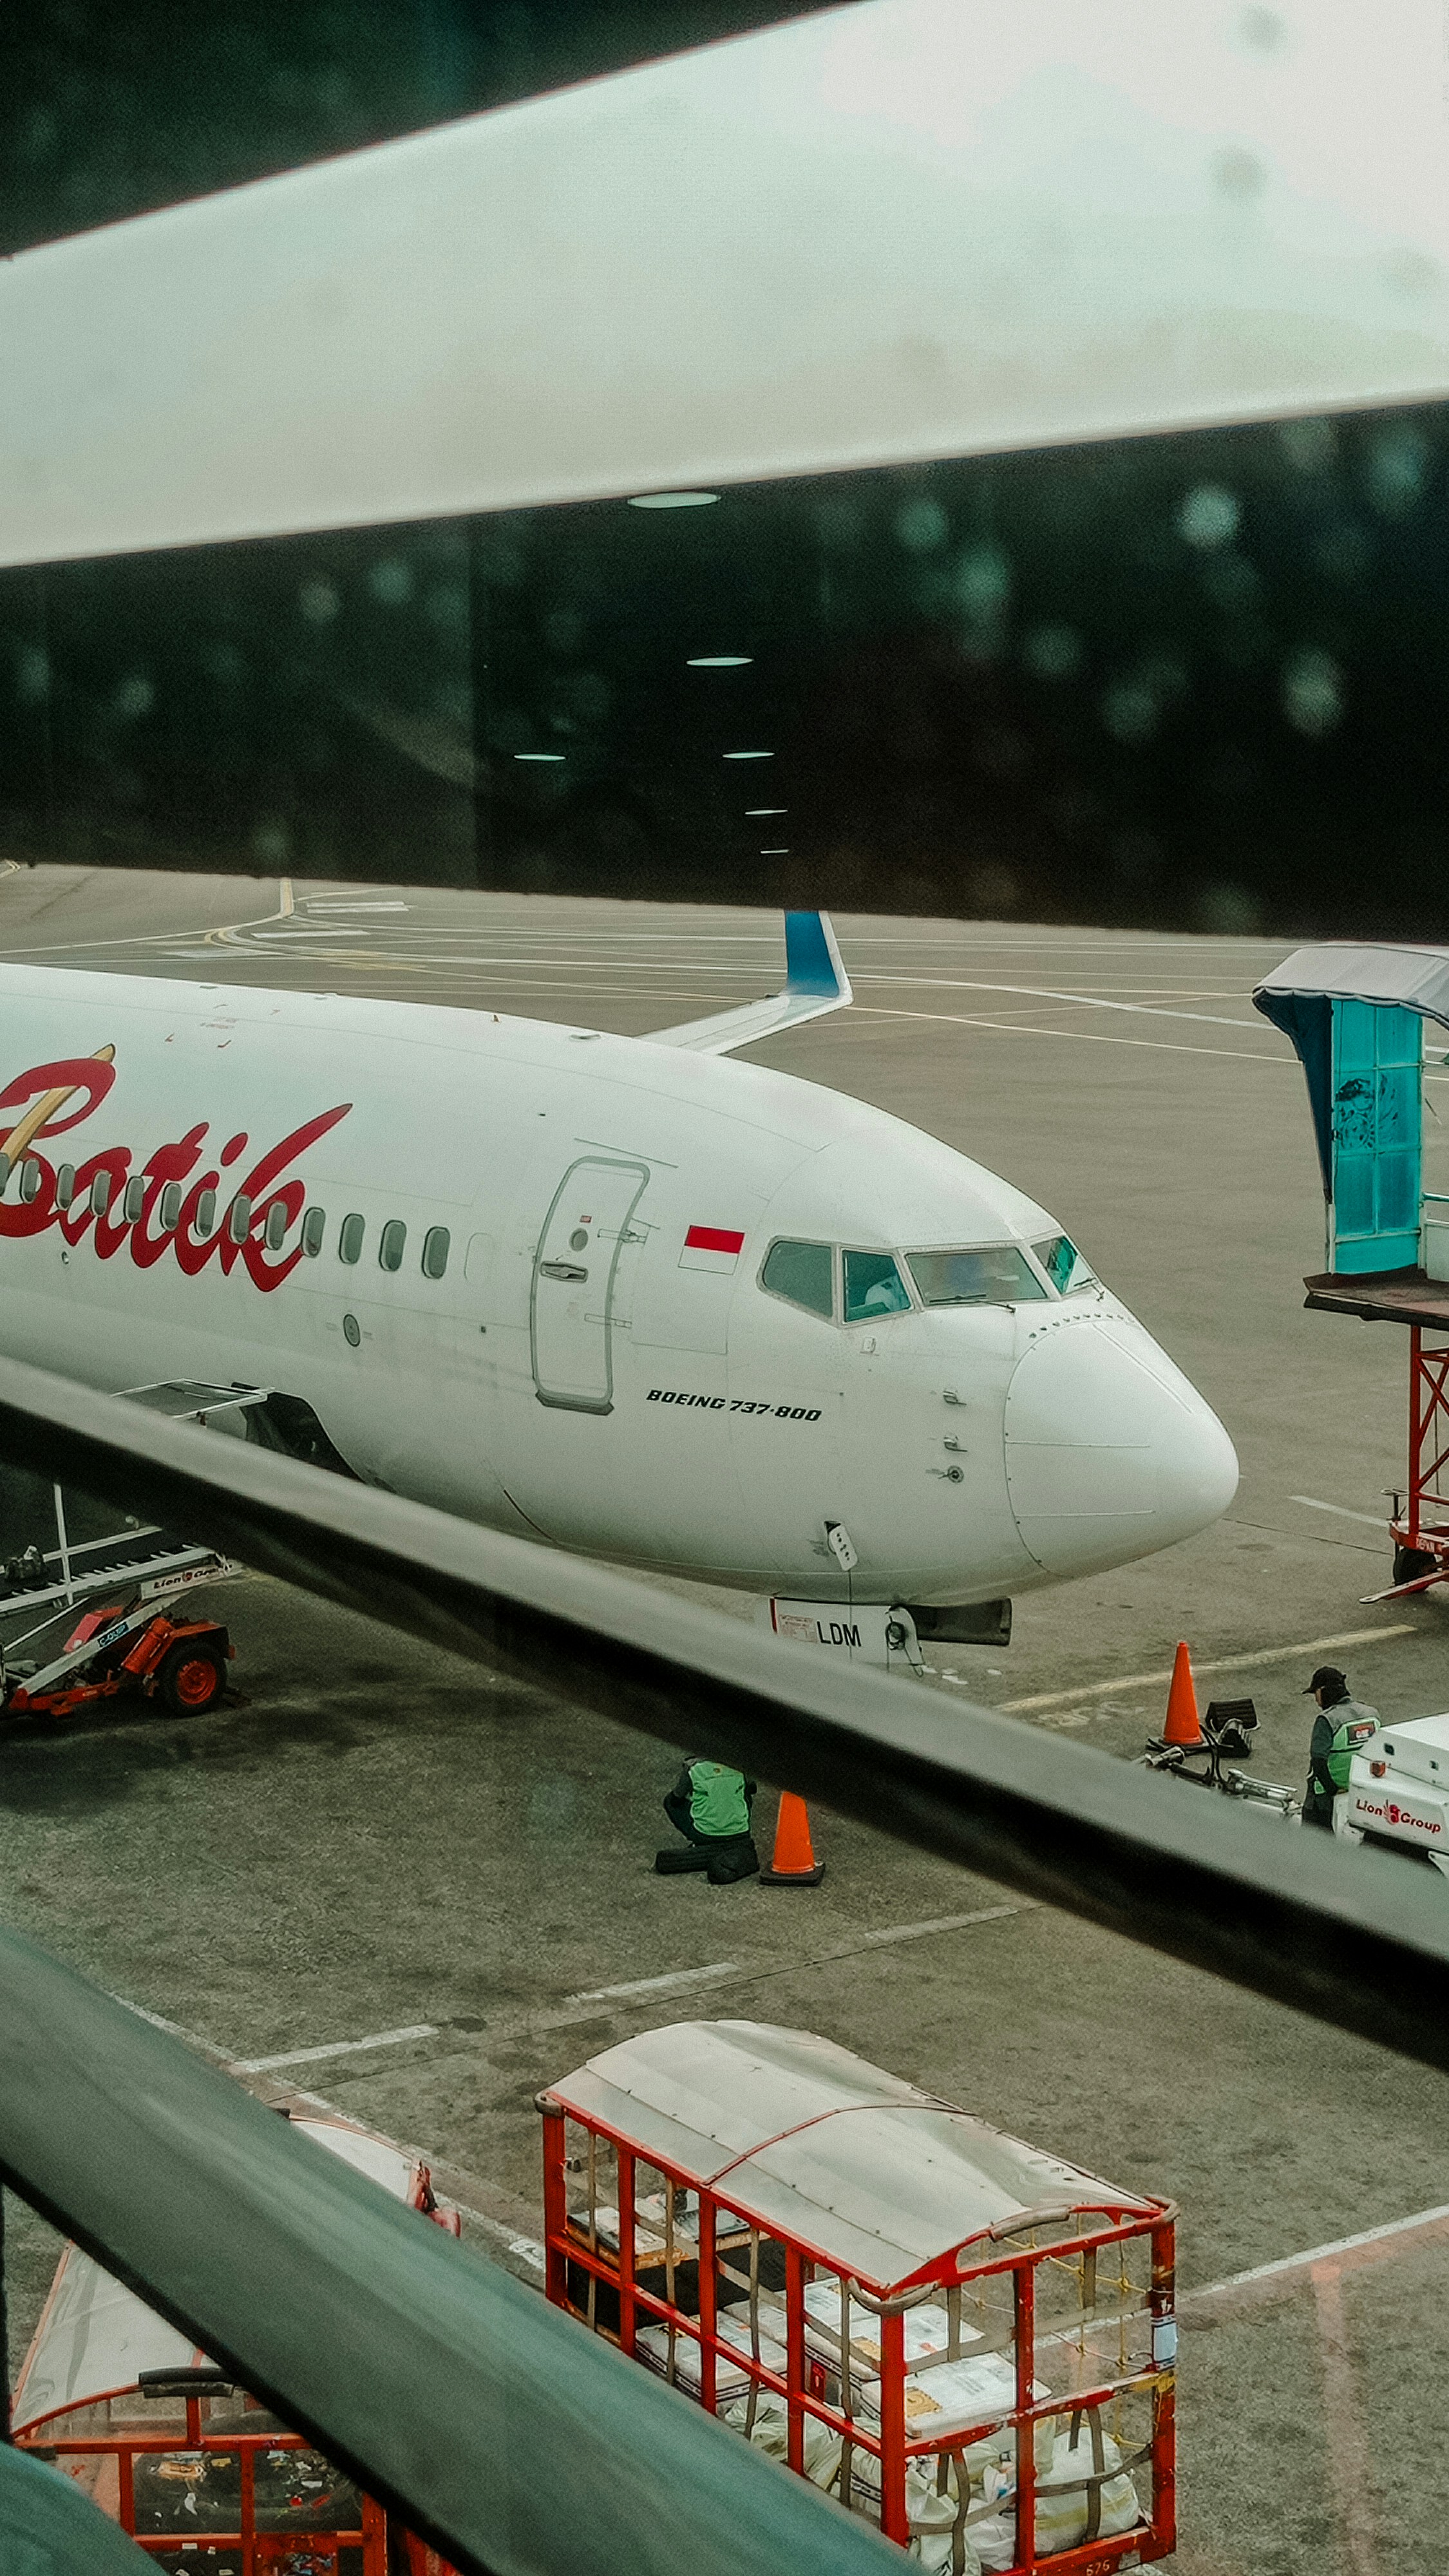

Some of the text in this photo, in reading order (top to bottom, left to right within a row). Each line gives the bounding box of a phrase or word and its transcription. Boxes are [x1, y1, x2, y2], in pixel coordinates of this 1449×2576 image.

[0, 1044, 353, 1292] Batik
[646, 1389, 822, 1421] BOEING 737-800
[153, 1577, 182, 1589] Lion
[817, 1620, 862, 1647] LDM
[1356, 1798, 1441, 1834] Lion Group
